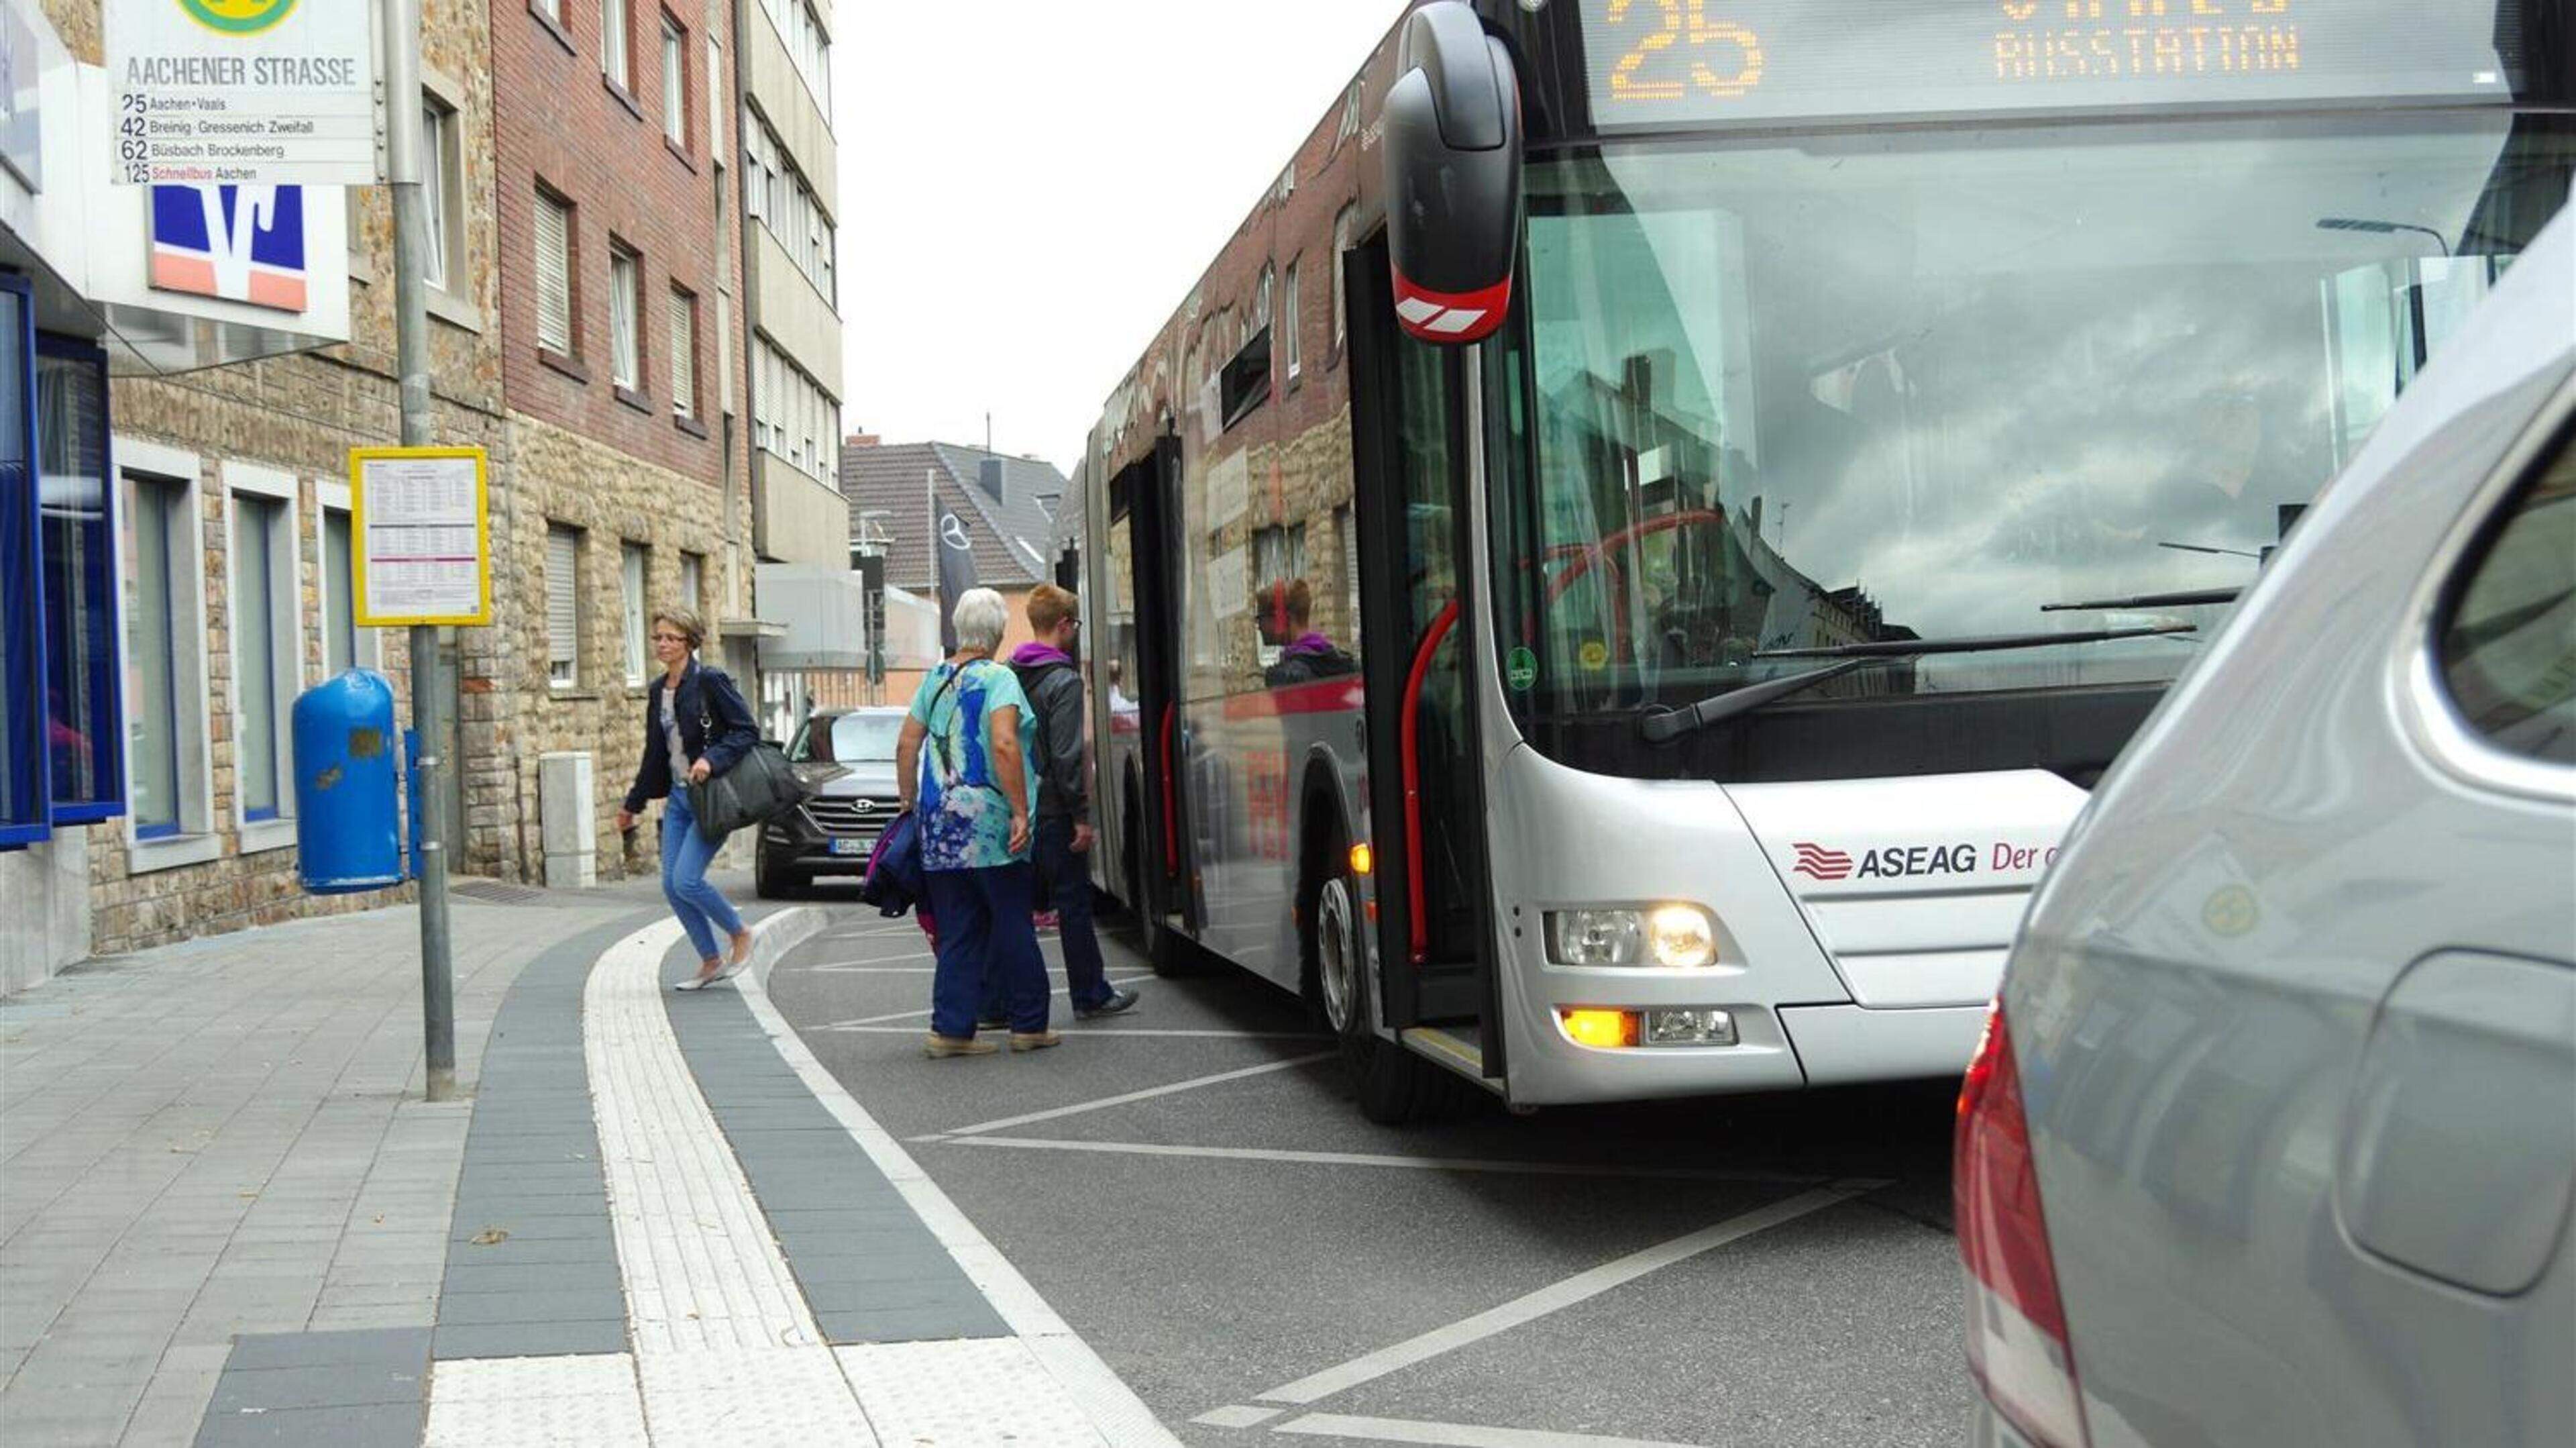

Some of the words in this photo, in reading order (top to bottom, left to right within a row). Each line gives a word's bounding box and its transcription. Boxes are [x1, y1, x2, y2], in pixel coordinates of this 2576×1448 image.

[1608, 0, 1764, 99] 25
[127, 56, 246, 85] AACHENER
[254, 56, 356, 85] STRASSE
[122, 93, 147, 113] 25
[121, 116, 146, 136] 42
[150, 120, 192, 136] Breinig
[199, 119, 266, 134] Gressenich
[268, 120, 315, 133] Zweifall
[121, 140, 148, 160] 62
[125, 164, 150, 183] 125
[152, 166, 213, 179] Schnellbus
[215, 166, 257, 179] Aachen
[1857, 843, 1977, 878] ASEAG
[1992, 842, 2038, 870] Der
